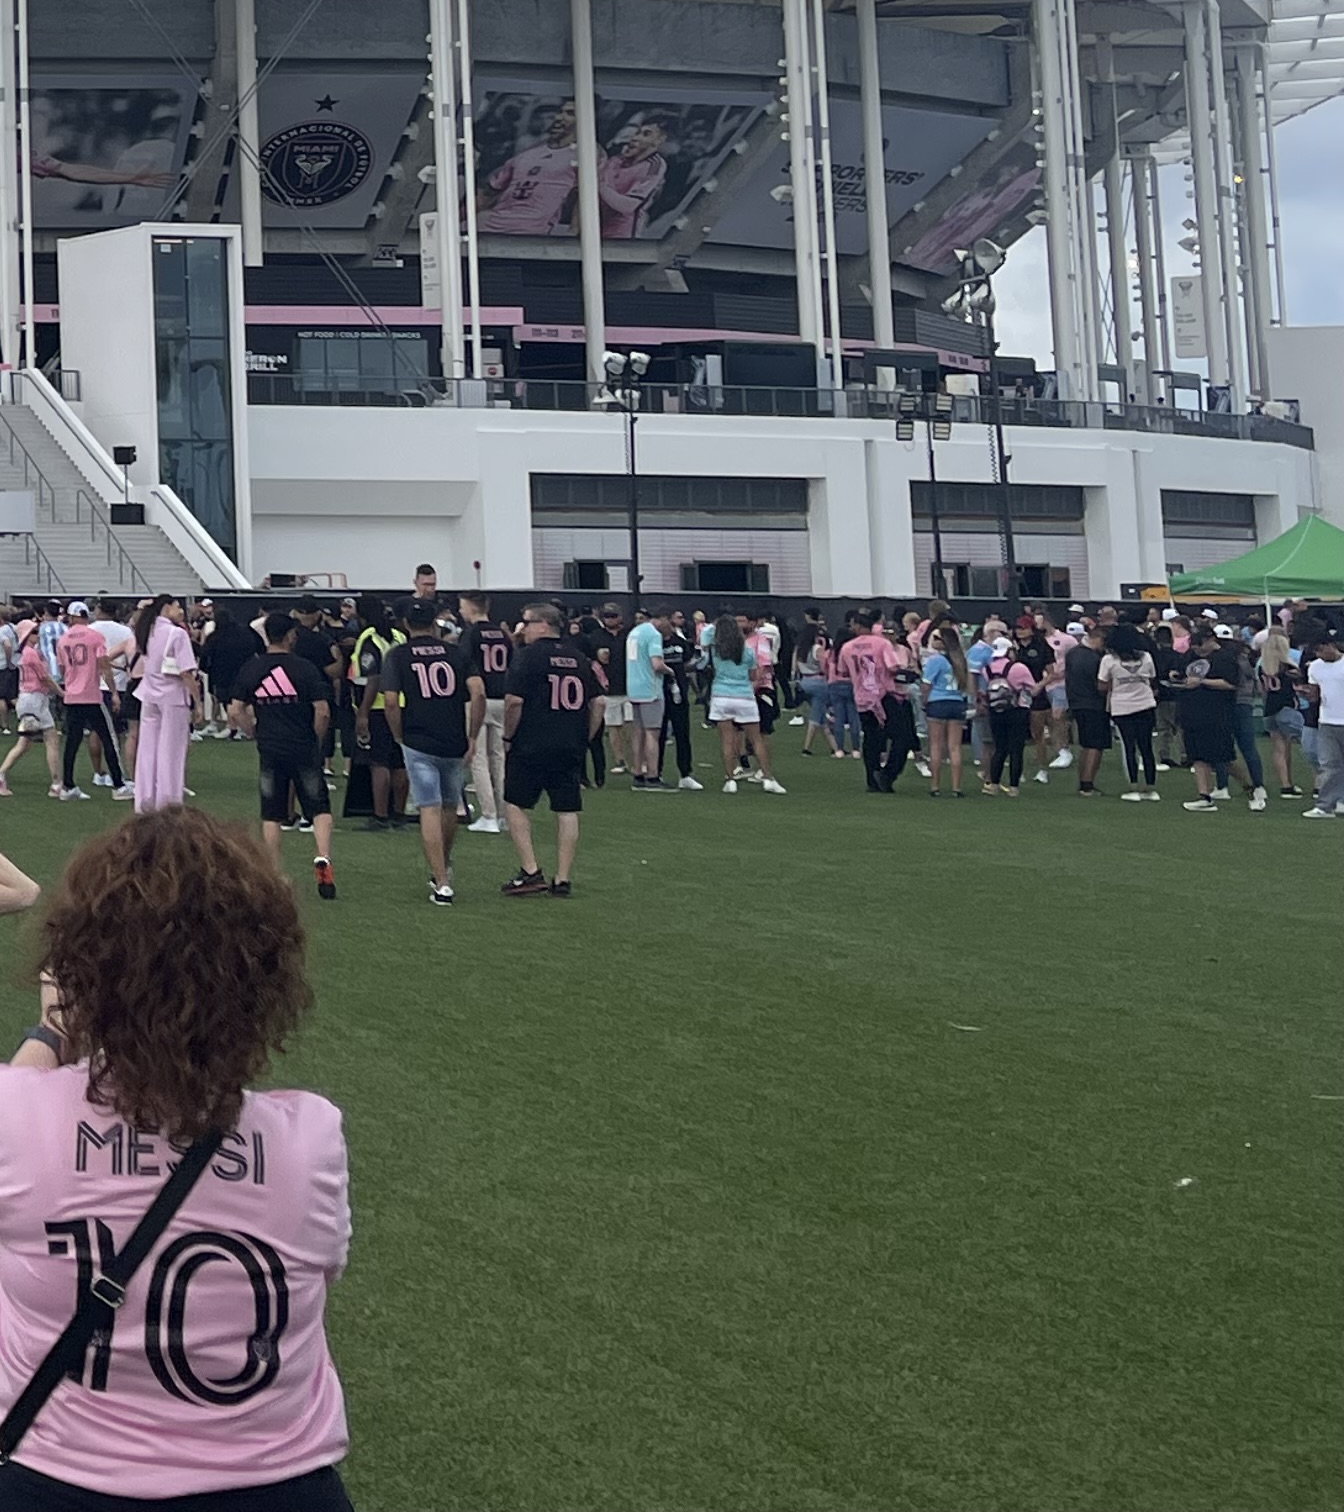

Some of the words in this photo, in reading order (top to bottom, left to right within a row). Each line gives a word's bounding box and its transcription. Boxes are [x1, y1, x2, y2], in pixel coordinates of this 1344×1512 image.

[63, 644, 89, 666] 10
[479, 643, 507, 673] 10
[410, 661, 456, 699] 10
[547, 674, 584, 710] 10
[44, 1217, 289, 1408] 10
